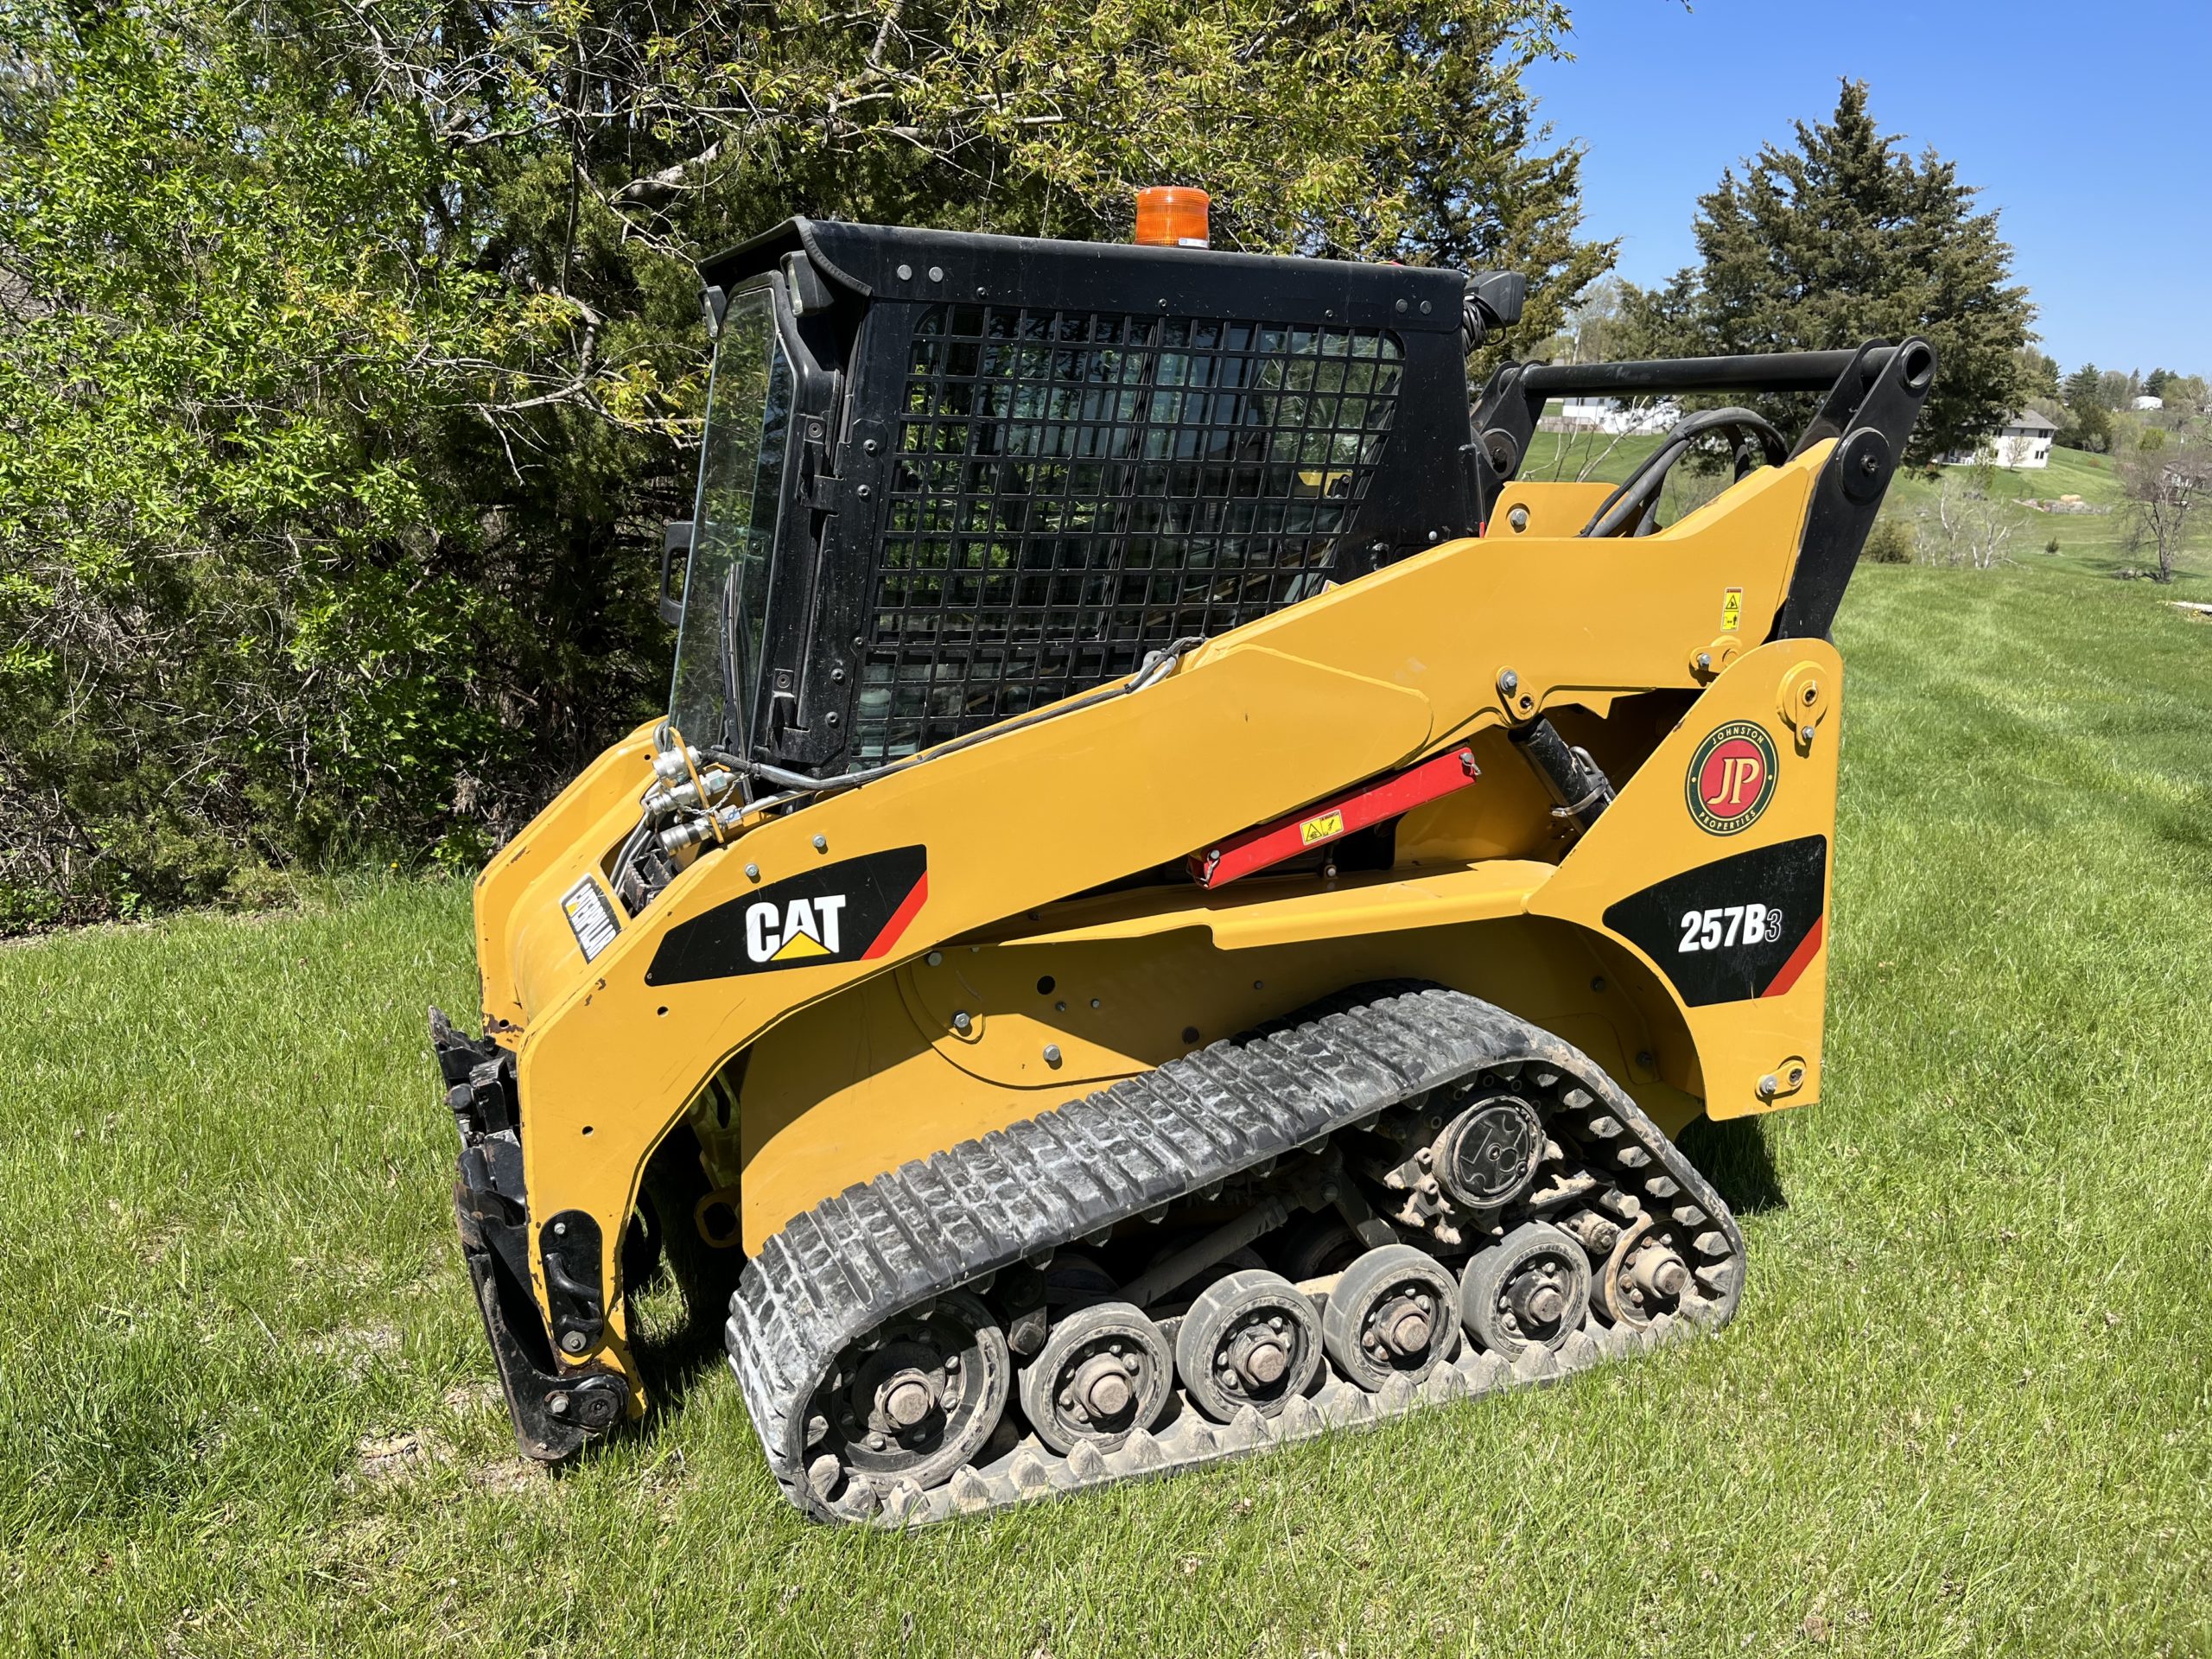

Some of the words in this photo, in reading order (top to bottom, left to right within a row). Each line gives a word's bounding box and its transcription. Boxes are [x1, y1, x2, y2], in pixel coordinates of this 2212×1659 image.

[1712, 726, 1764, 745] JOHNSTON
[1707, 757, 1760, 804] JP
[1699, 810, 1756, 830] PROPERTIES
[565, 882, 617, 961] CATERPILLAR
[745, 894, 846, 963] CAT
[1678, 903, 1783, 952] 257B3
